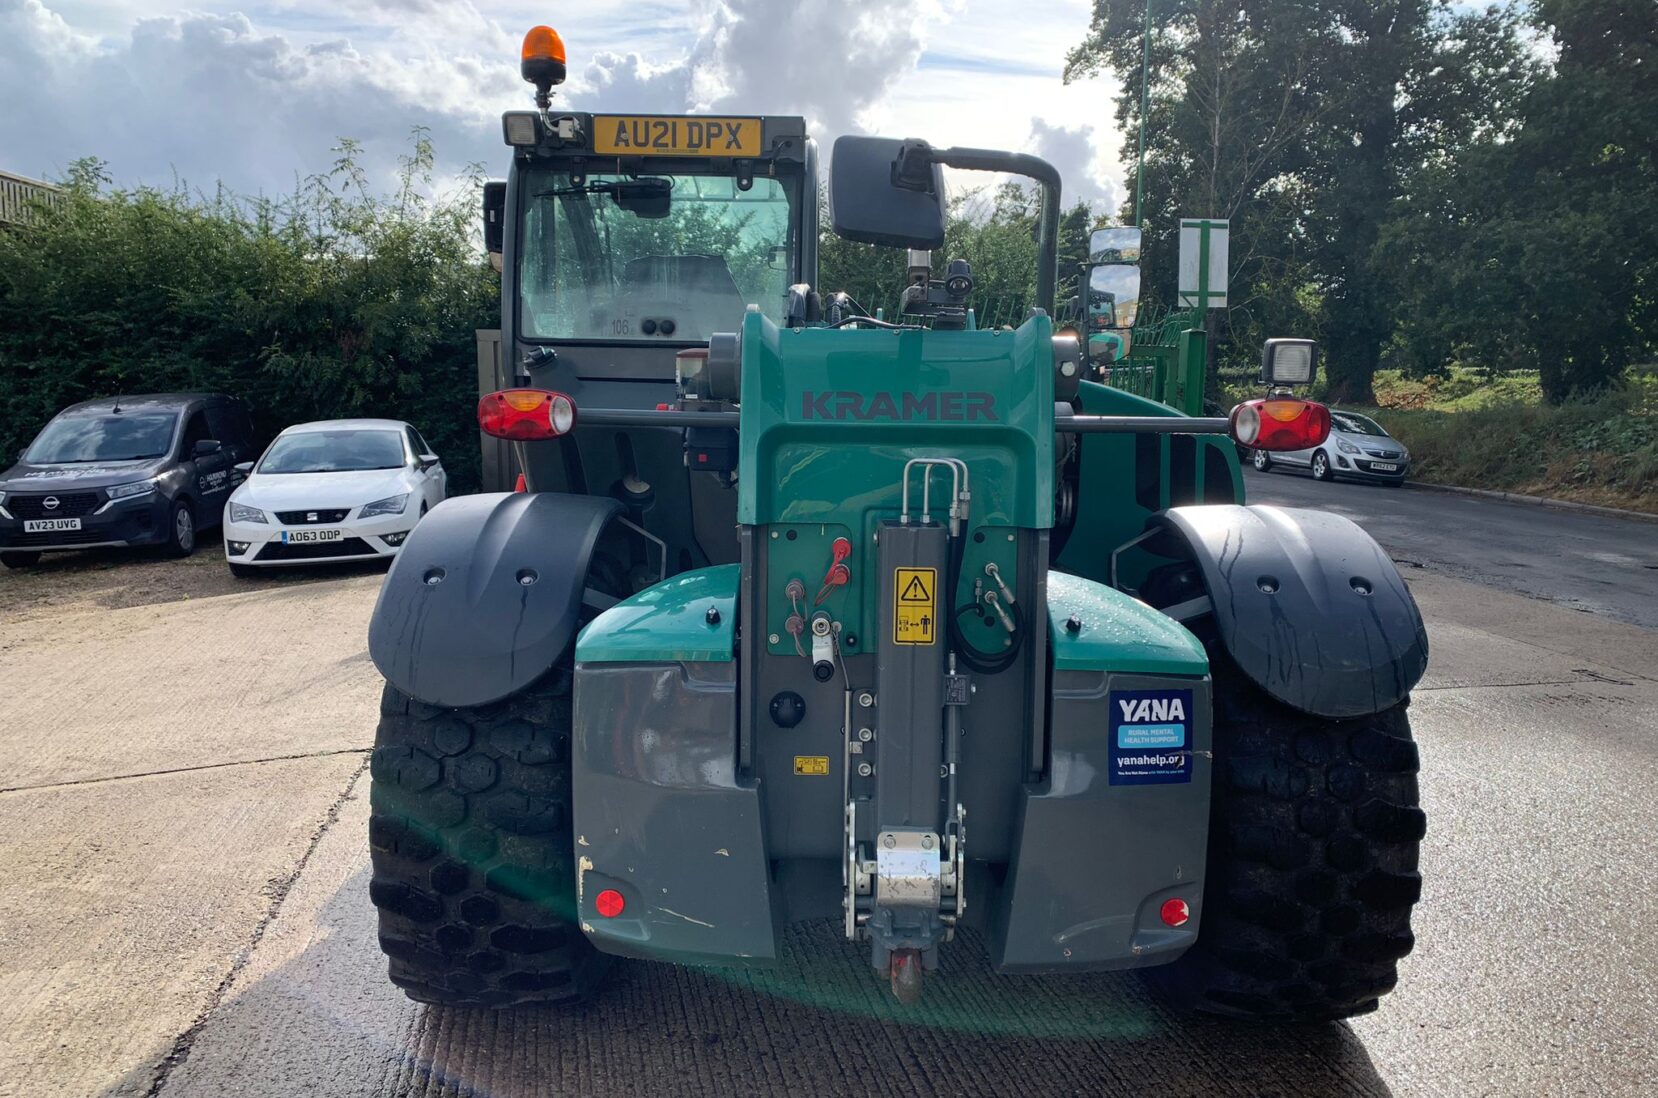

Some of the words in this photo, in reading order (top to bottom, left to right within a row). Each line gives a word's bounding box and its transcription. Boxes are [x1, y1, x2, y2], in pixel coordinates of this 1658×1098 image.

[614, 120, 677, 148] AU21
[687, 122, 742, 150] DPX
[612, 319, 629, 335] 106
[802, 391, 999, 421] KRAMER
[29, 521, 55, 531] AV23
[57, 519, 77, 529] UVG
[1119, 698, 1185, 722] YANA
[1124, 736, 1150, 744] HEALTH
[1150, 735, 1179, 743] SUPPORT
[1150, 728, 1175, 736] MENTAL
